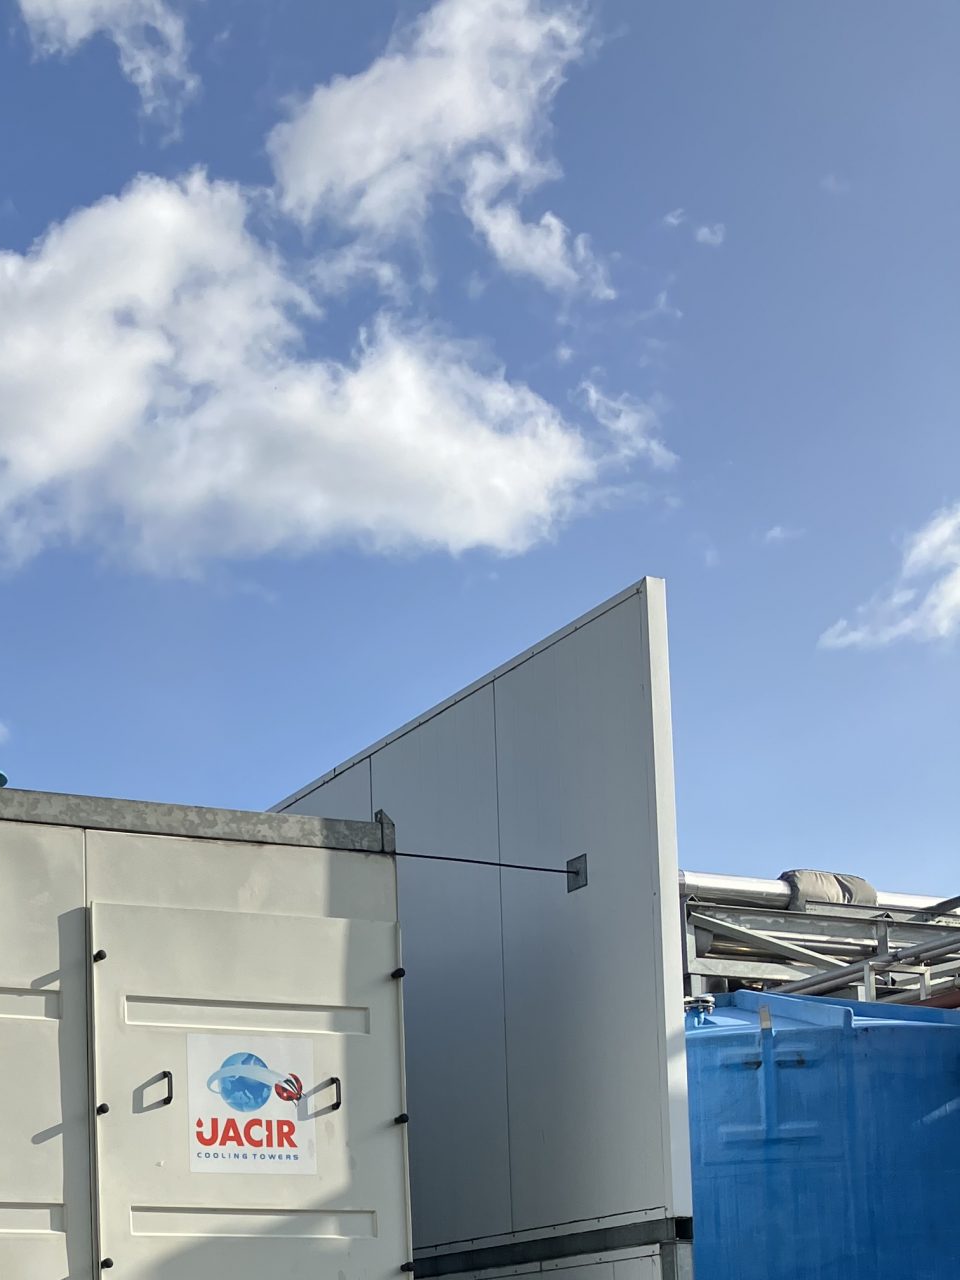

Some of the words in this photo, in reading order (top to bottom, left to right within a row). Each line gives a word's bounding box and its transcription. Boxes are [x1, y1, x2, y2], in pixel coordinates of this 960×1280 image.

[196, 1117, 298, 1148] JACIR
[197, 1151, 248, 1160] COOLING
[252, 1153, 299, 1161] TOWERS
